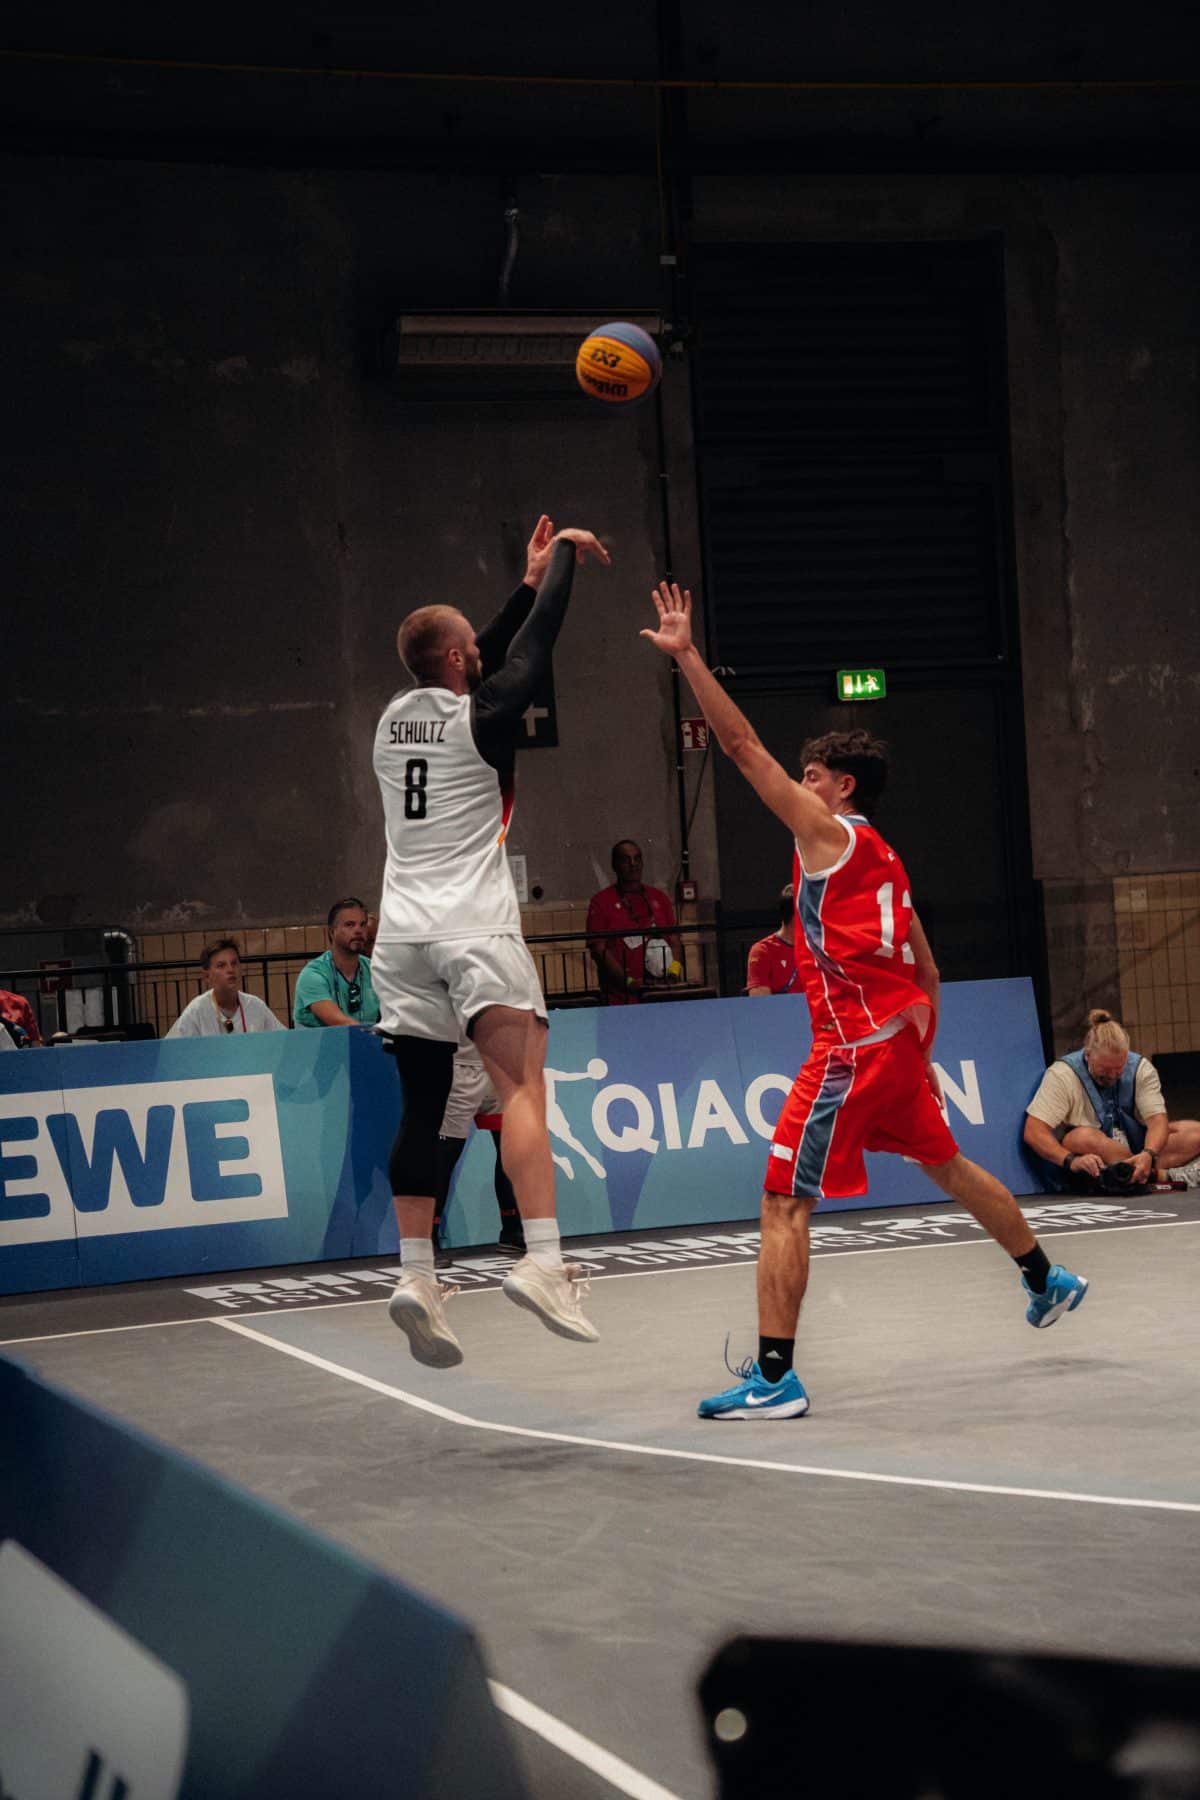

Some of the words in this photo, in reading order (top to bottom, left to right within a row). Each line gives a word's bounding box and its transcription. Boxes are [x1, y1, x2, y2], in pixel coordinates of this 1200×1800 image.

[389, 720, 447, 744] SCHULTZ
[404, 758, 428, 820] 8
[591, 1060, 985, 1154] QIAON
[0, 1098, 263, 1221] EWE
[213, 1285, 362, 1308] FISU
[614, 1223, 958, 1265] UNIVRSITY
[969, 1209, 1179, 1229] AMES
